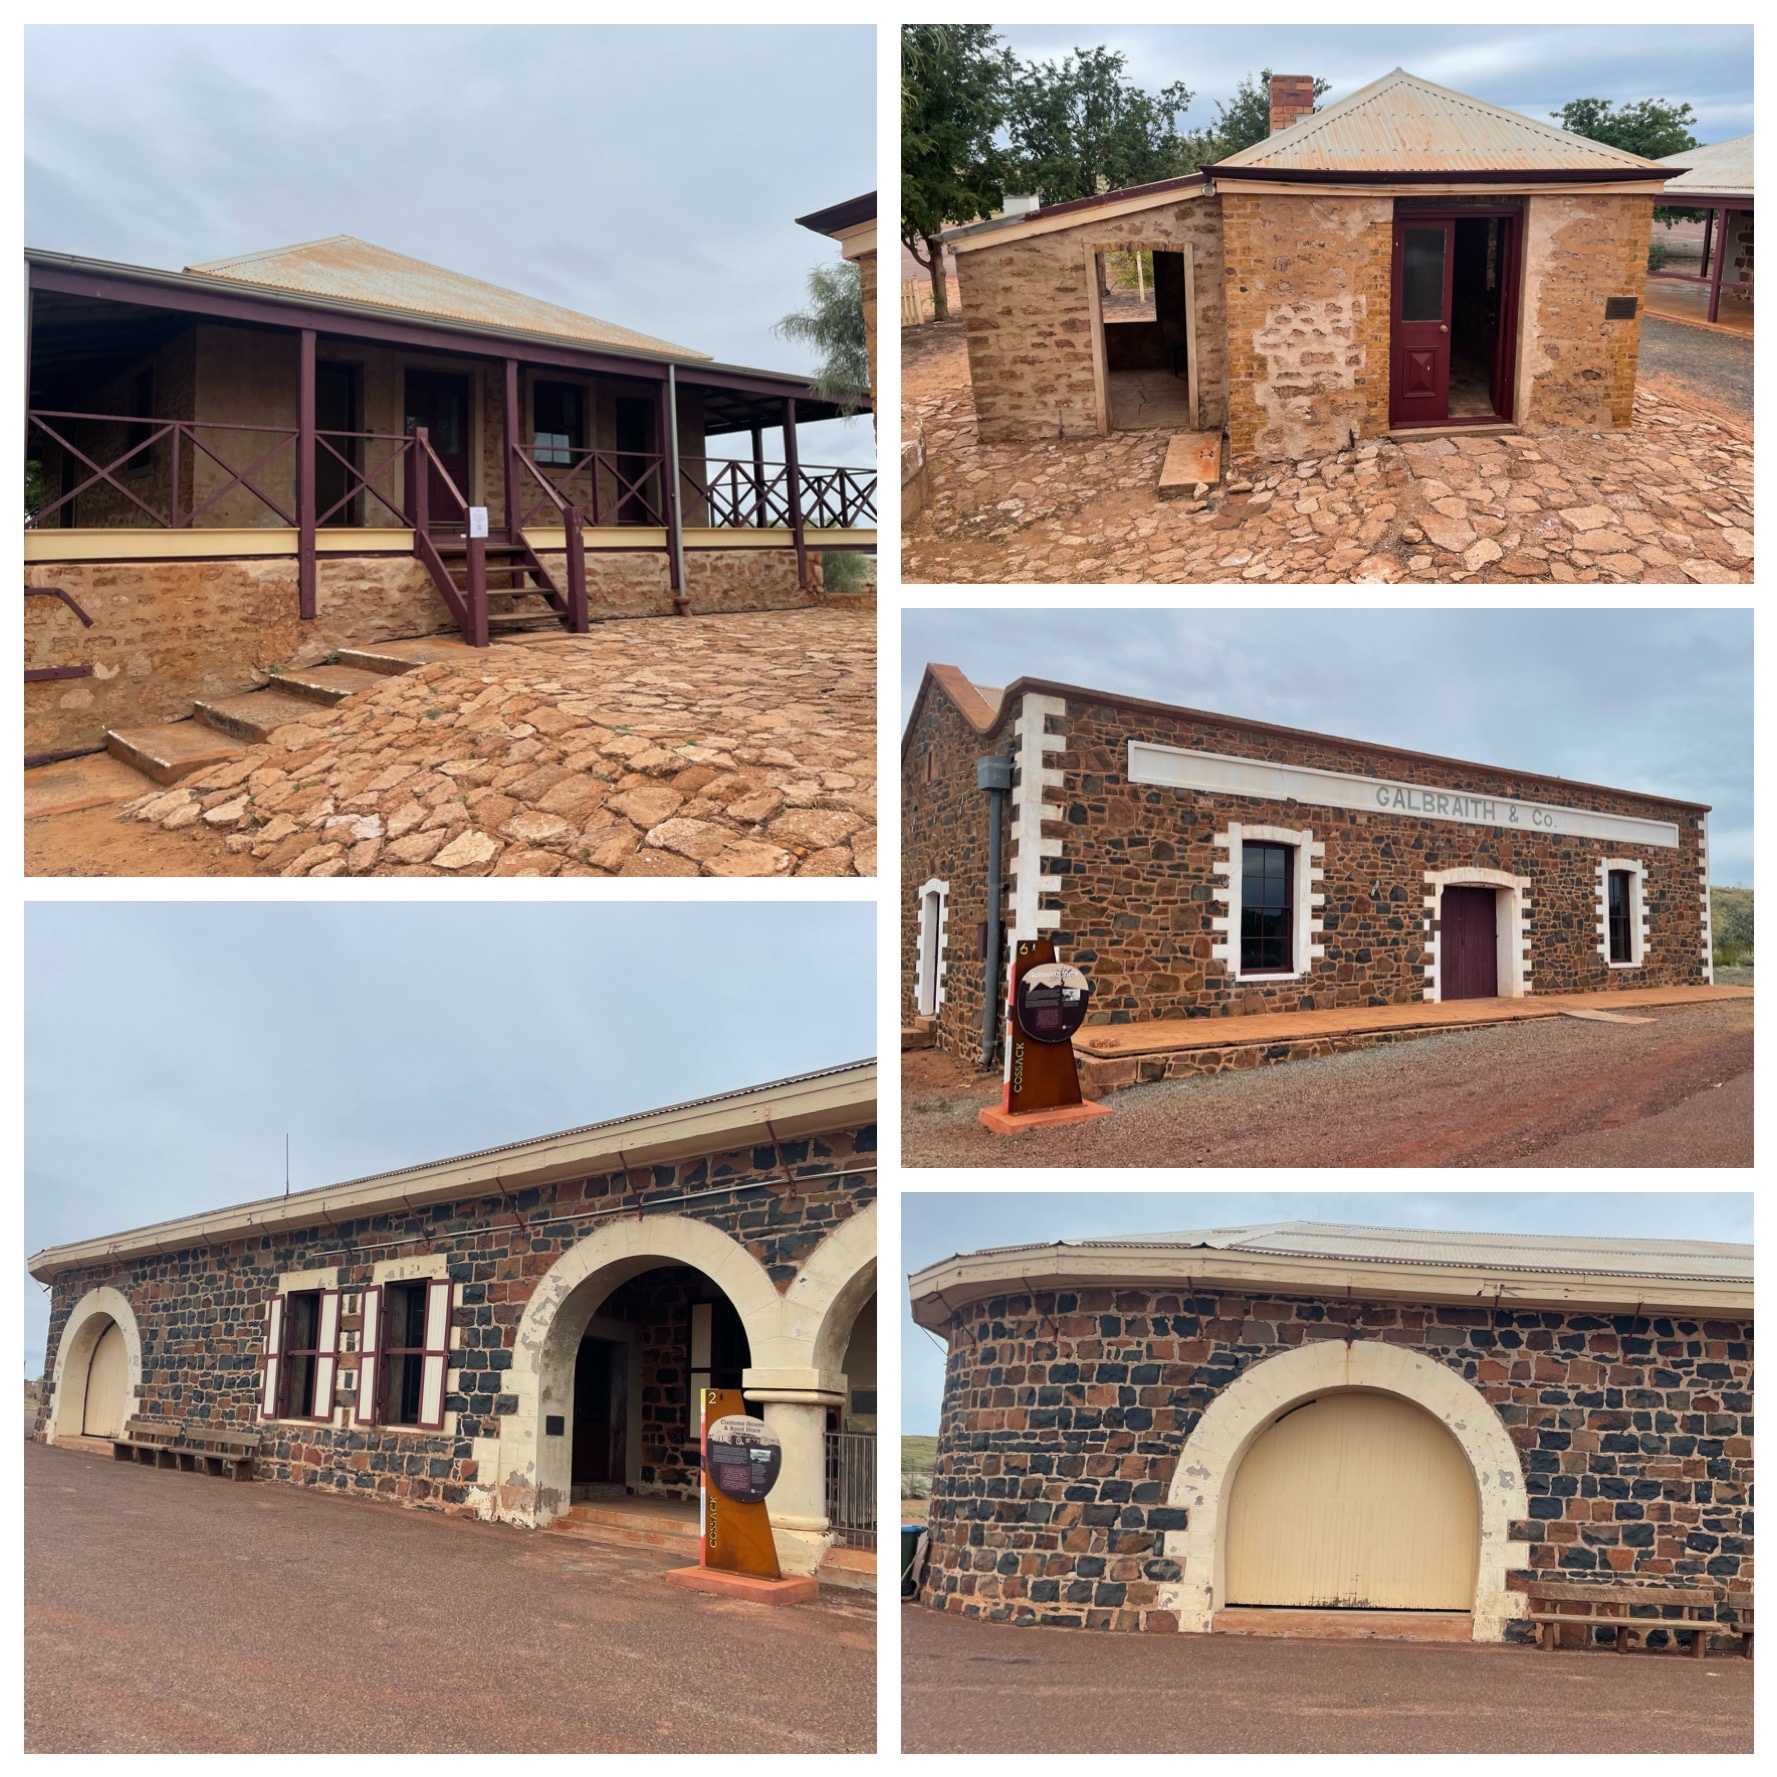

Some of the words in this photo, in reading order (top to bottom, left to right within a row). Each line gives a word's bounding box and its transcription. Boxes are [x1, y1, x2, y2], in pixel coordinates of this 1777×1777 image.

[1376, 786, 1496, 821] GALBRAITH
[1508, 805, 1519, 824] &
[1532, 808, 1557, 828] Co.
[1020, 943, 1028, 955] 6
[1014, 1042, 1024, 1093] COSSACK
[709, 1392, 717, 1404] 2
